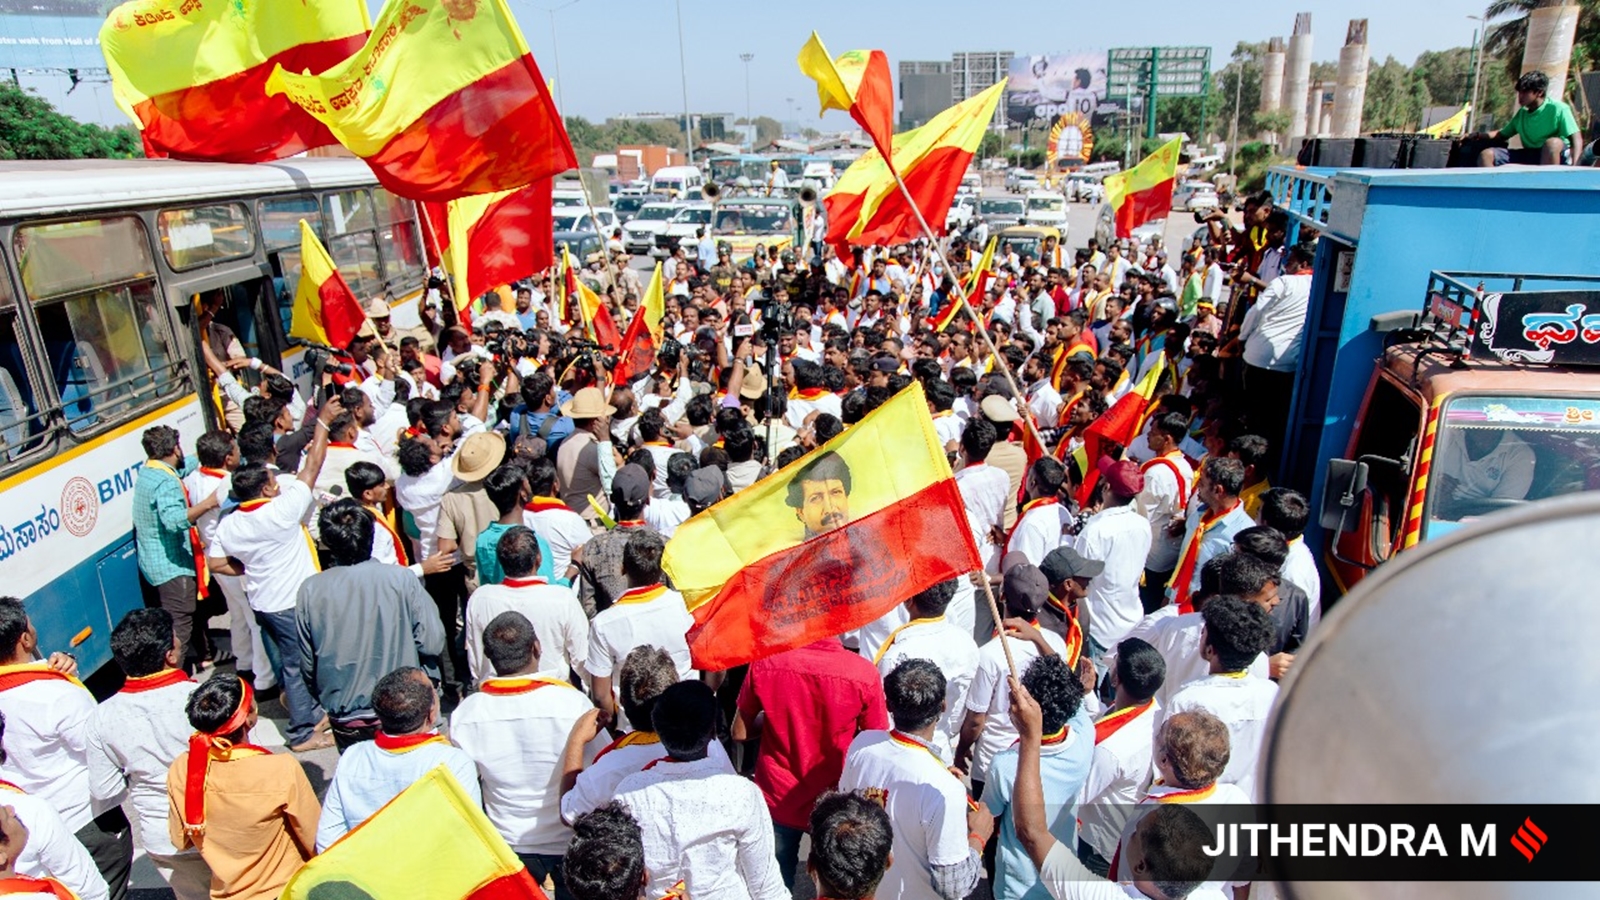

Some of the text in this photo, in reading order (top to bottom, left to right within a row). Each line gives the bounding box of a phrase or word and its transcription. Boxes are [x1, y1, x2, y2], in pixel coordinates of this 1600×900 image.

[18, 37, 40, 45] walk
[41, 37, 63, 45] from
[84, 37, 93, 45] of
